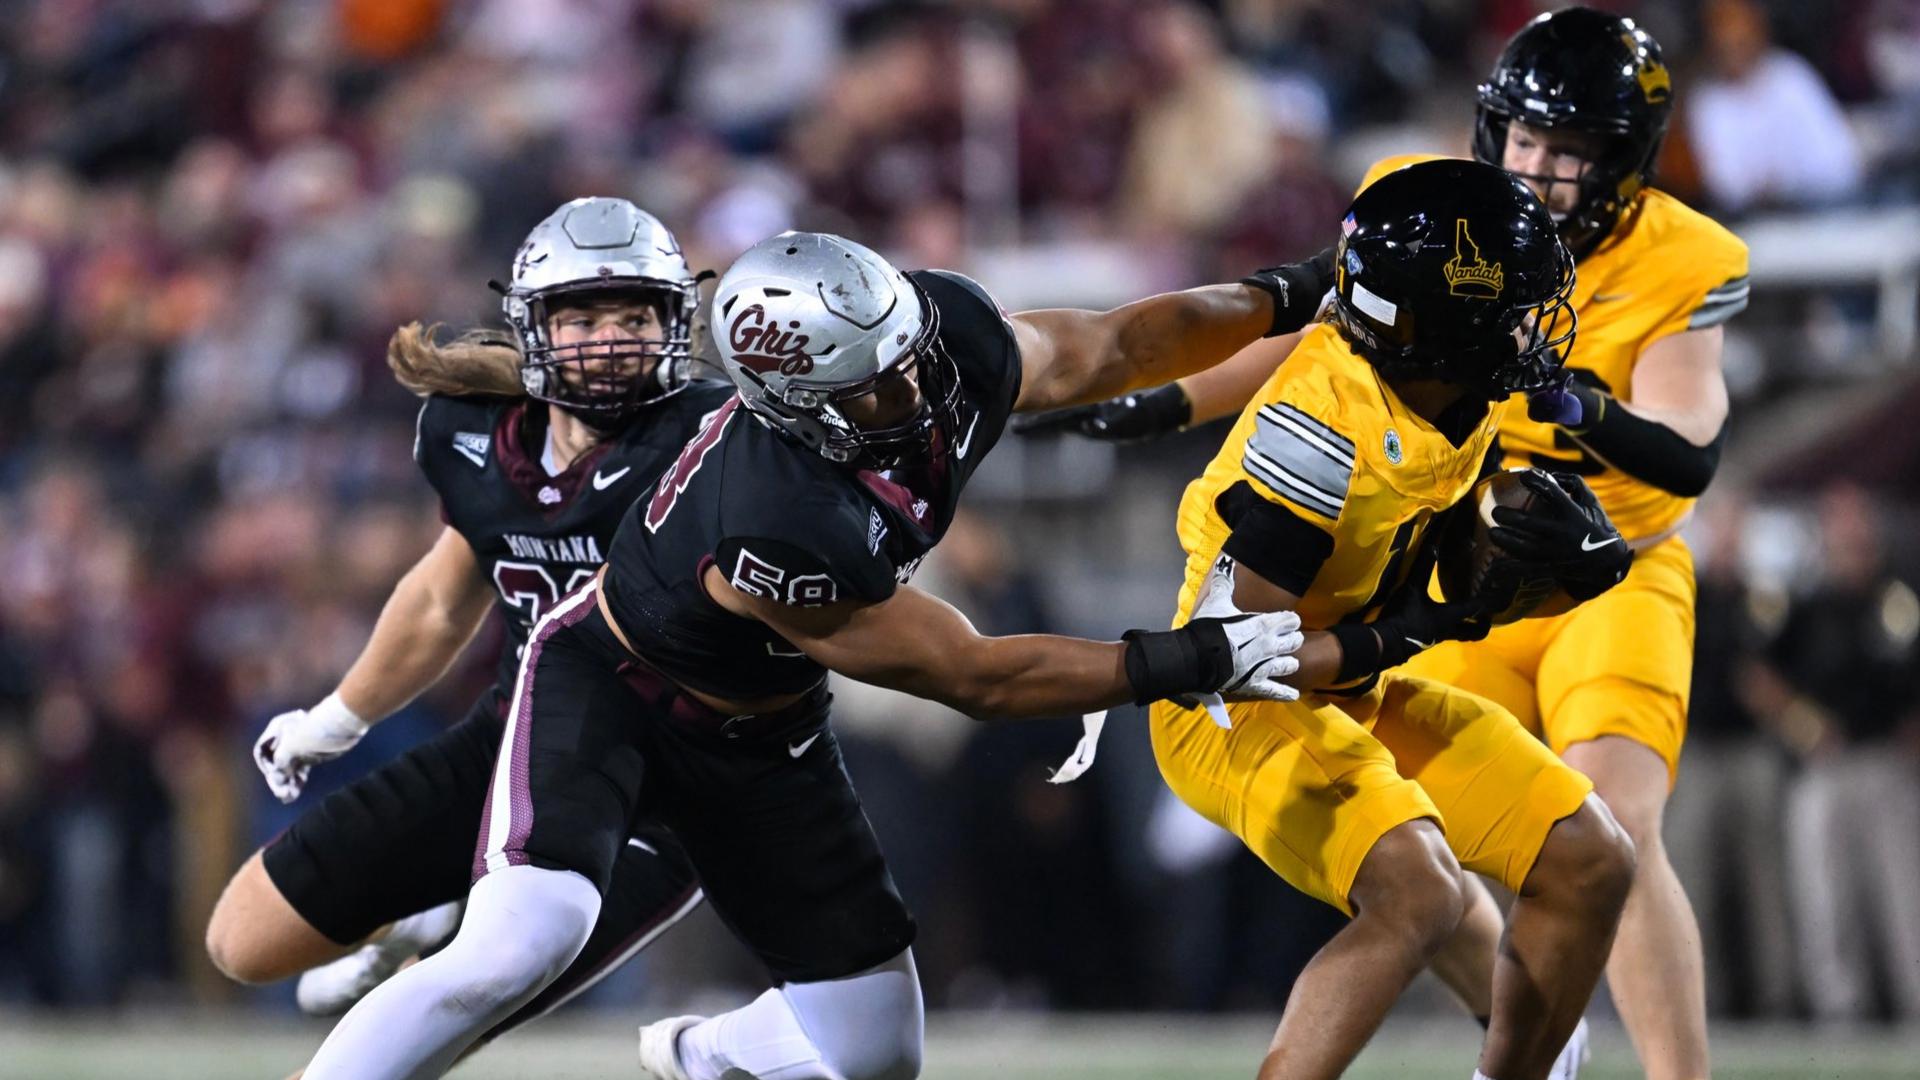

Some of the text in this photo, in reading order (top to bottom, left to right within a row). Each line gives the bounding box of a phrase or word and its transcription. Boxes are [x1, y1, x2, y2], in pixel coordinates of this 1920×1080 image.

[1444, 256, 1503, 290] Vandals
[729, 303, 814, 376] Griz
[503, 534, 603, 562] MONTANA
